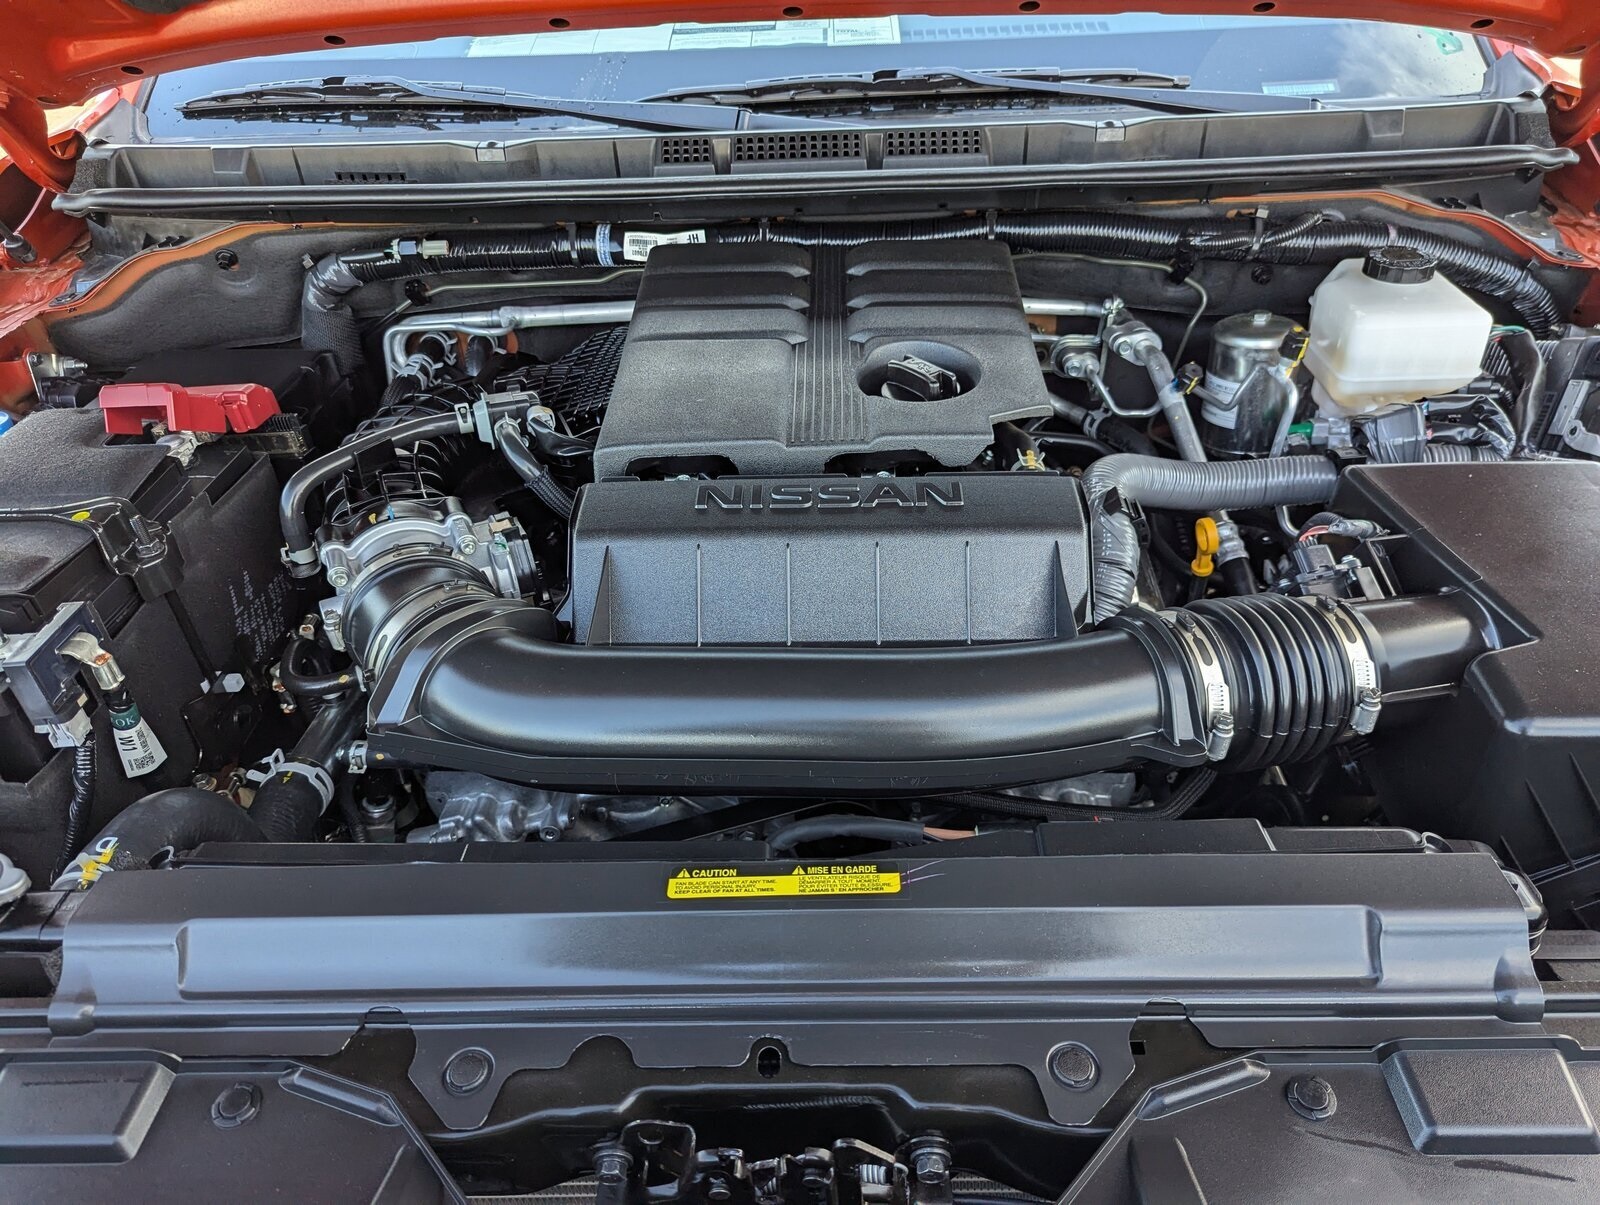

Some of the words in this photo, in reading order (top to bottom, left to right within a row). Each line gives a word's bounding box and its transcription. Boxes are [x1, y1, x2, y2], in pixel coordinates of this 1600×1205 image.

[695, 482, 964, 509] NISSAN
[116, 716, 135, 726] OK
[692, 869, 736, 878] CAUTION
[845, 865, 877, 873] GARDE
